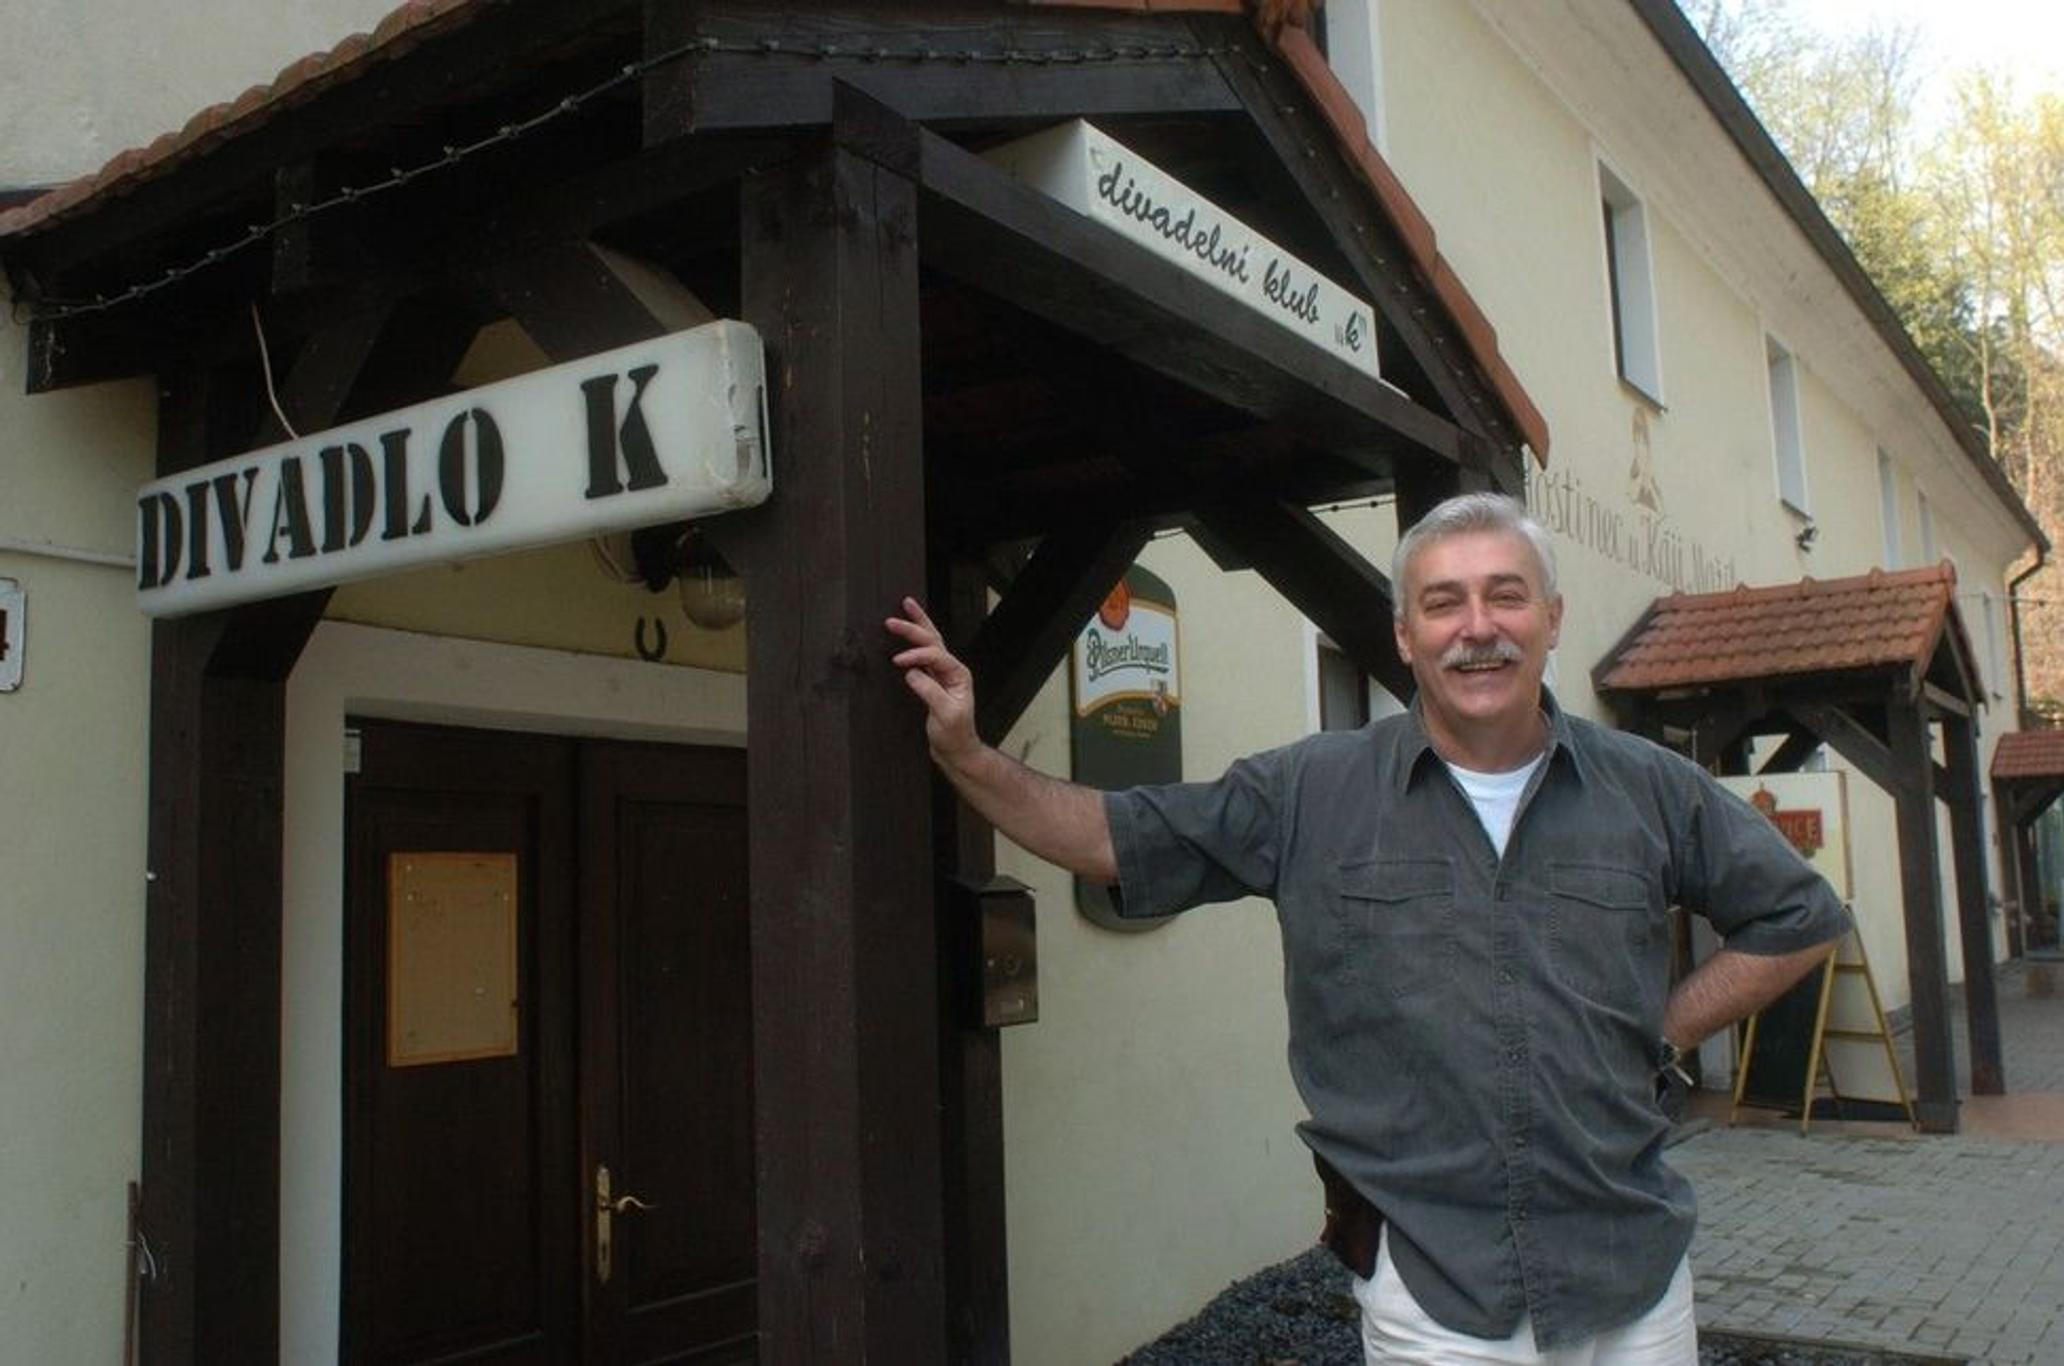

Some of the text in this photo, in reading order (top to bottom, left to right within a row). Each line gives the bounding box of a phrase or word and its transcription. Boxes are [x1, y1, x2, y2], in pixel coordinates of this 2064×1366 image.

[1263, 259, 1319, 324] klub
[138, 364, 669, 591] DIVADLO K
